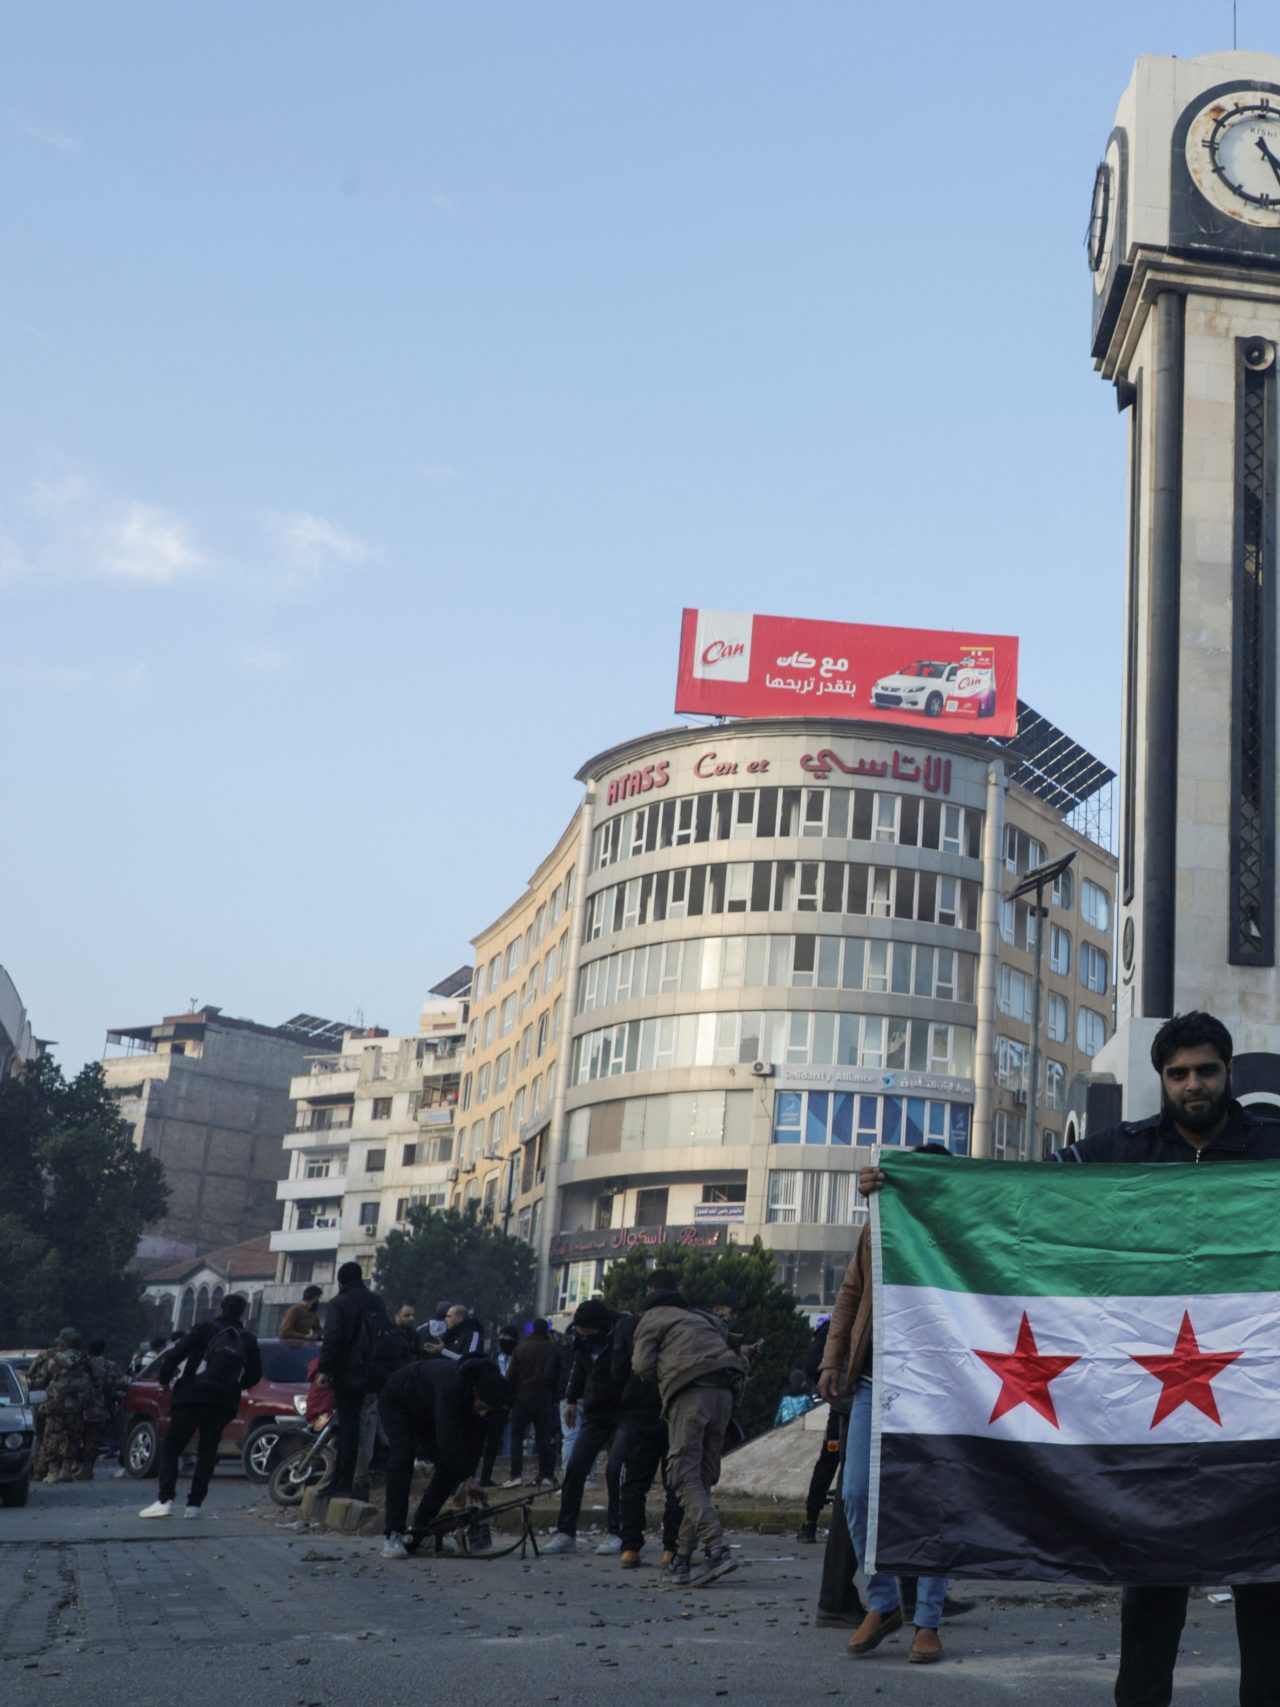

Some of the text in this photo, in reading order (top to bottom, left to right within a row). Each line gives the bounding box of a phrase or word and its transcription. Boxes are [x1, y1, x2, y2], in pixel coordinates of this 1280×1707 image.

[701, 639, 745, 665] Can
[819, 656, 849, 678] مع
[765, 673, 857, 698] بتقدر تربحها
[607, 760, 670, 806] ATASS
[836, 1070, 875, 1085] Alliance
